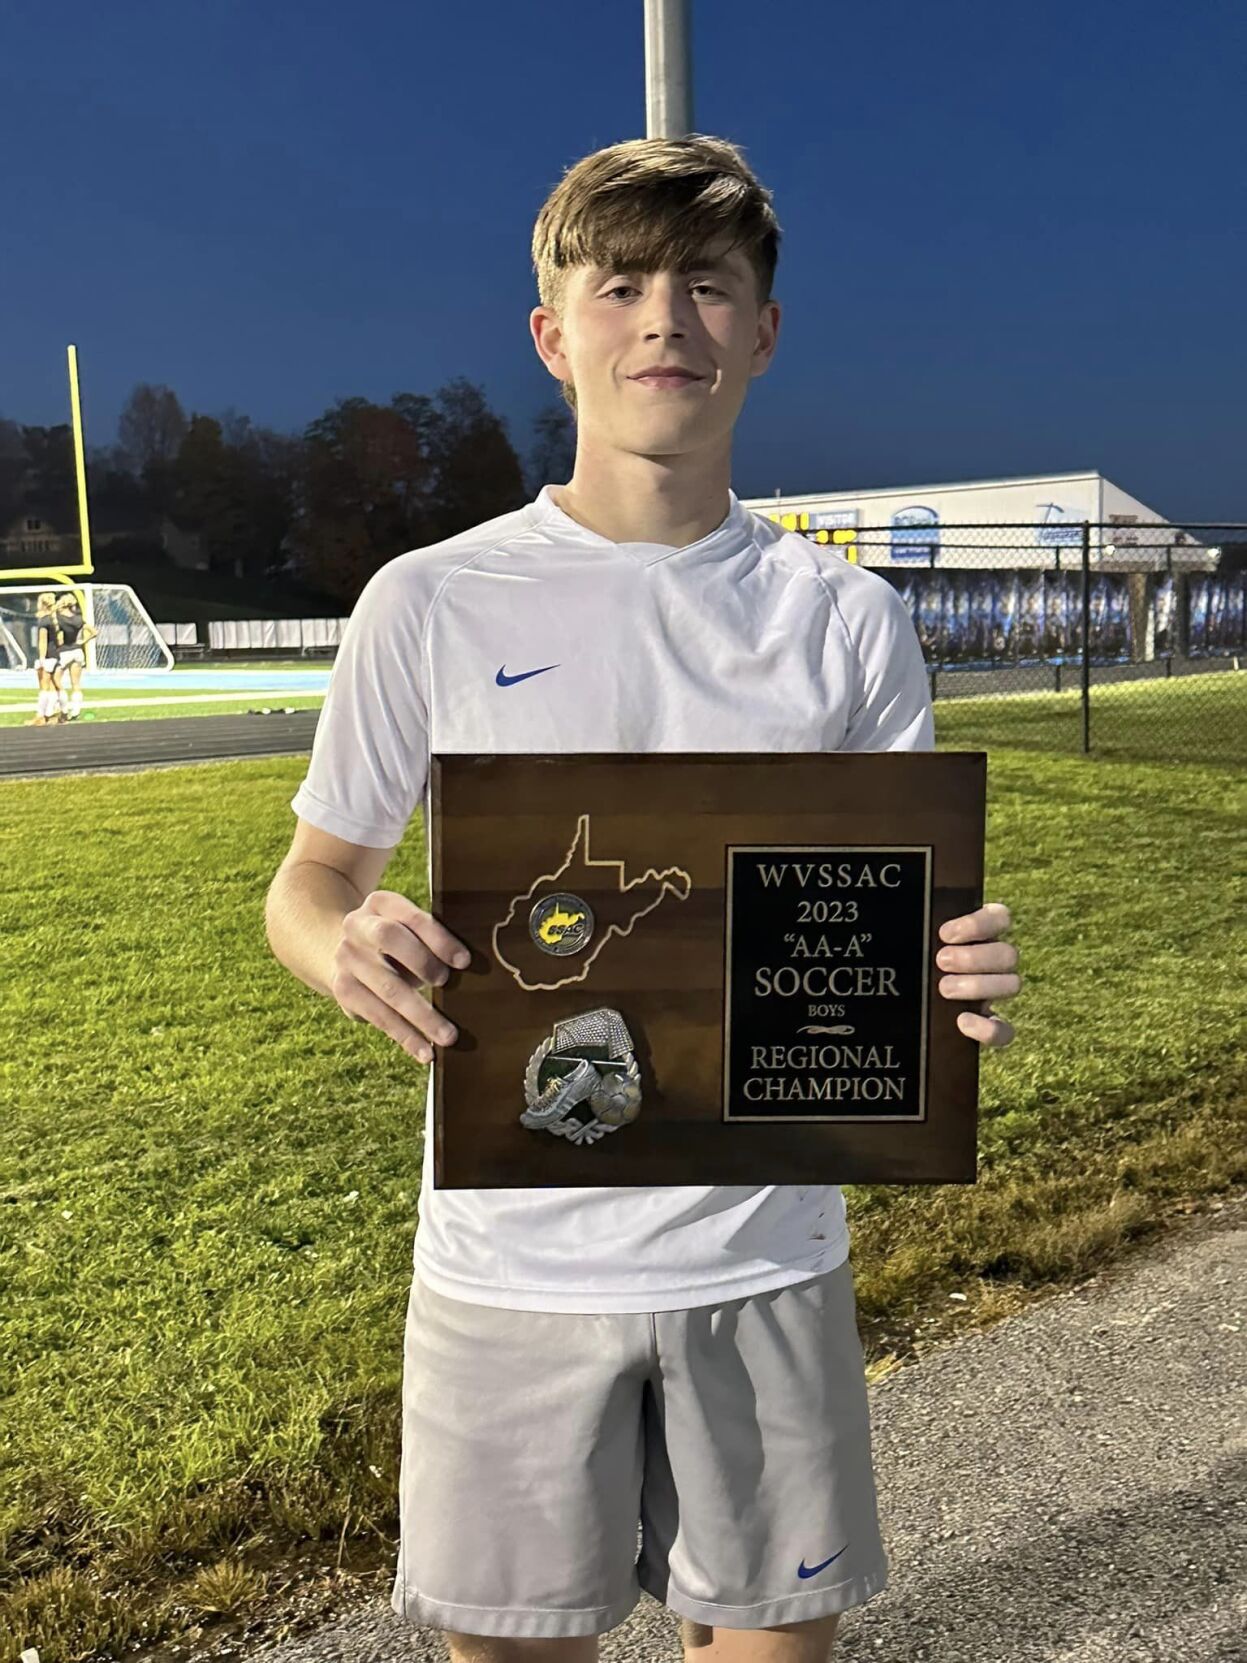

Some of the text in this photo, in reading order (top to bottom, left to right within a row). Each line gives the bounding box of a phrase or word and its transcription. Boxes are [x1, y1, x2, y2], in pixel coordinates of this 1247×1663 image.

[756, 863, 902, 888] WVSSAC
[797, 900, 859, 923] 2023
[754, 967, 901, 997] SOCCER
[808, 1004, 846, 1017] BOYS
[750, 1045, 901, 1069] REGIONAL
[743, 1077, 906, 1101] CHAMPION
